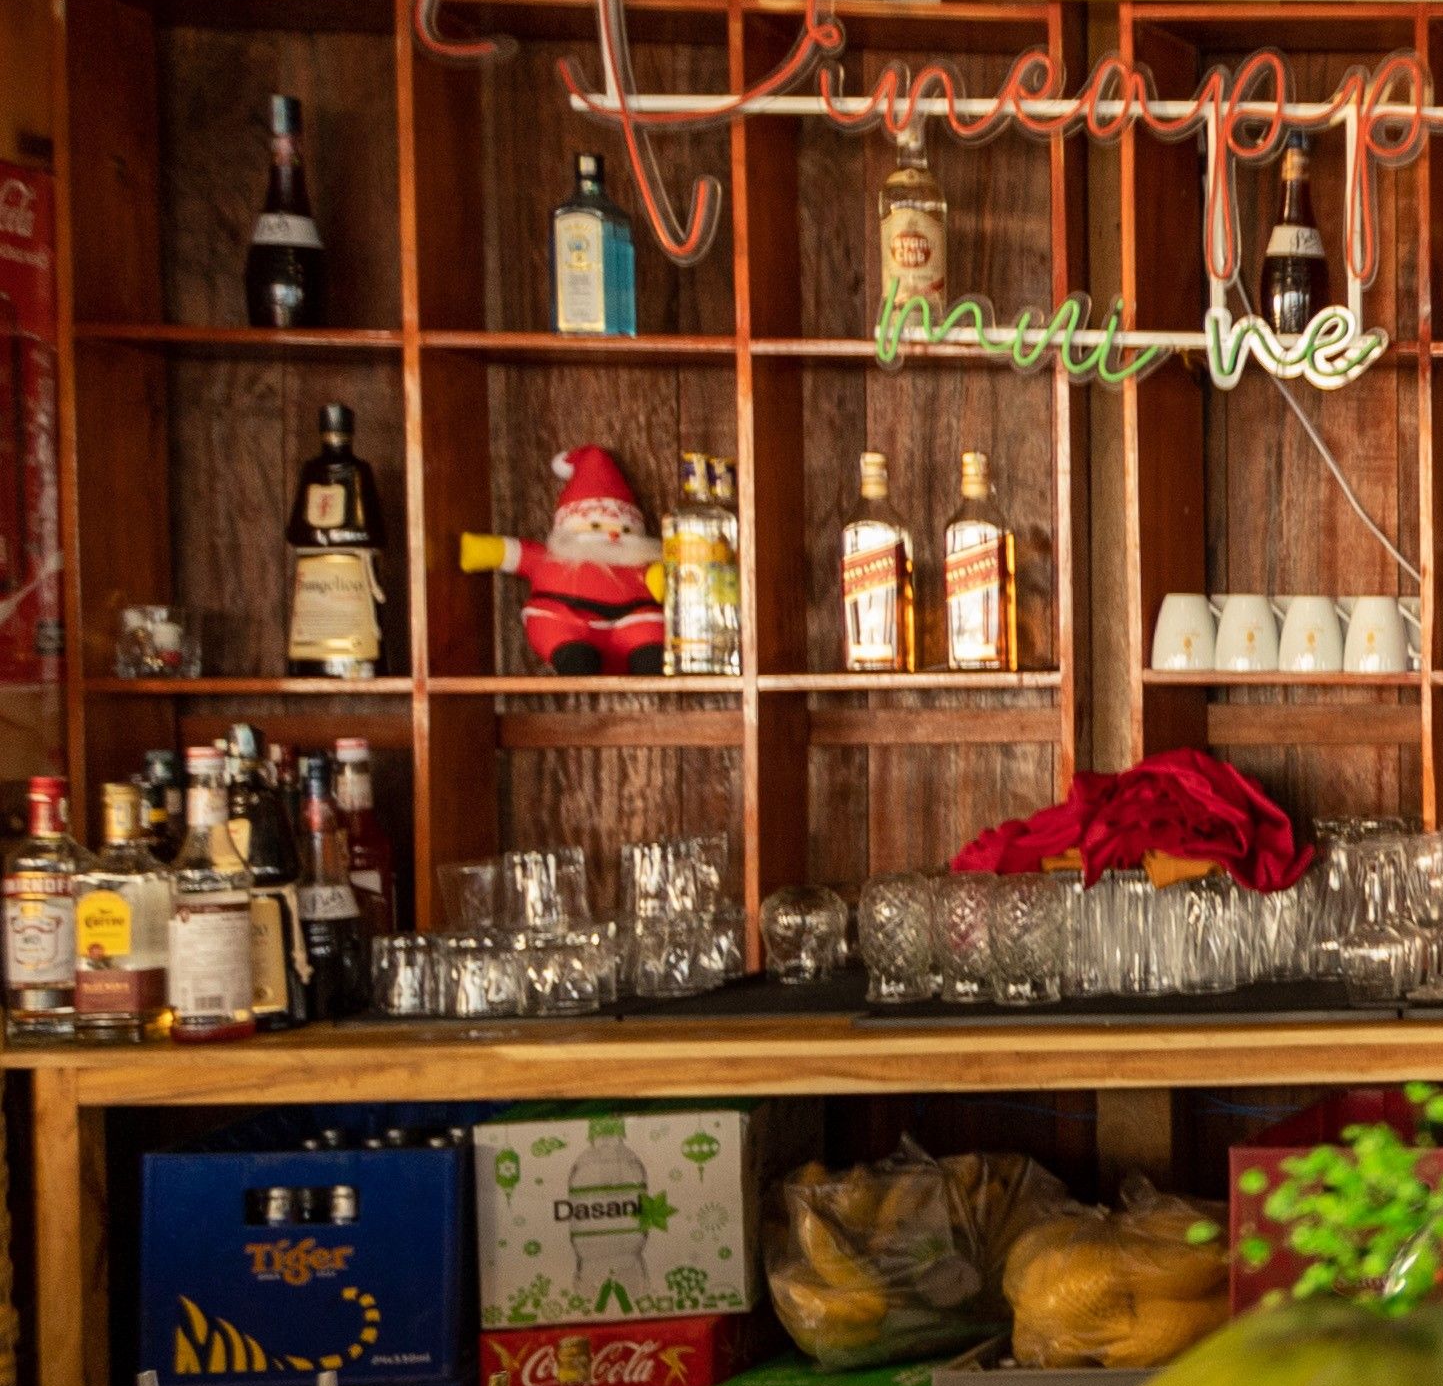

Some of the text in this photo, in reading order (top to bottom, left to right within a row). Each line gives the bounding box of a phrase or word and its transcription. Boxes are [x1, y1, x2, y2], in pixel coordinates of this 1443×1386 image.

[875, 277, 1388, 391] mui ne
[244, 1237, 354, 1286] Tiger
